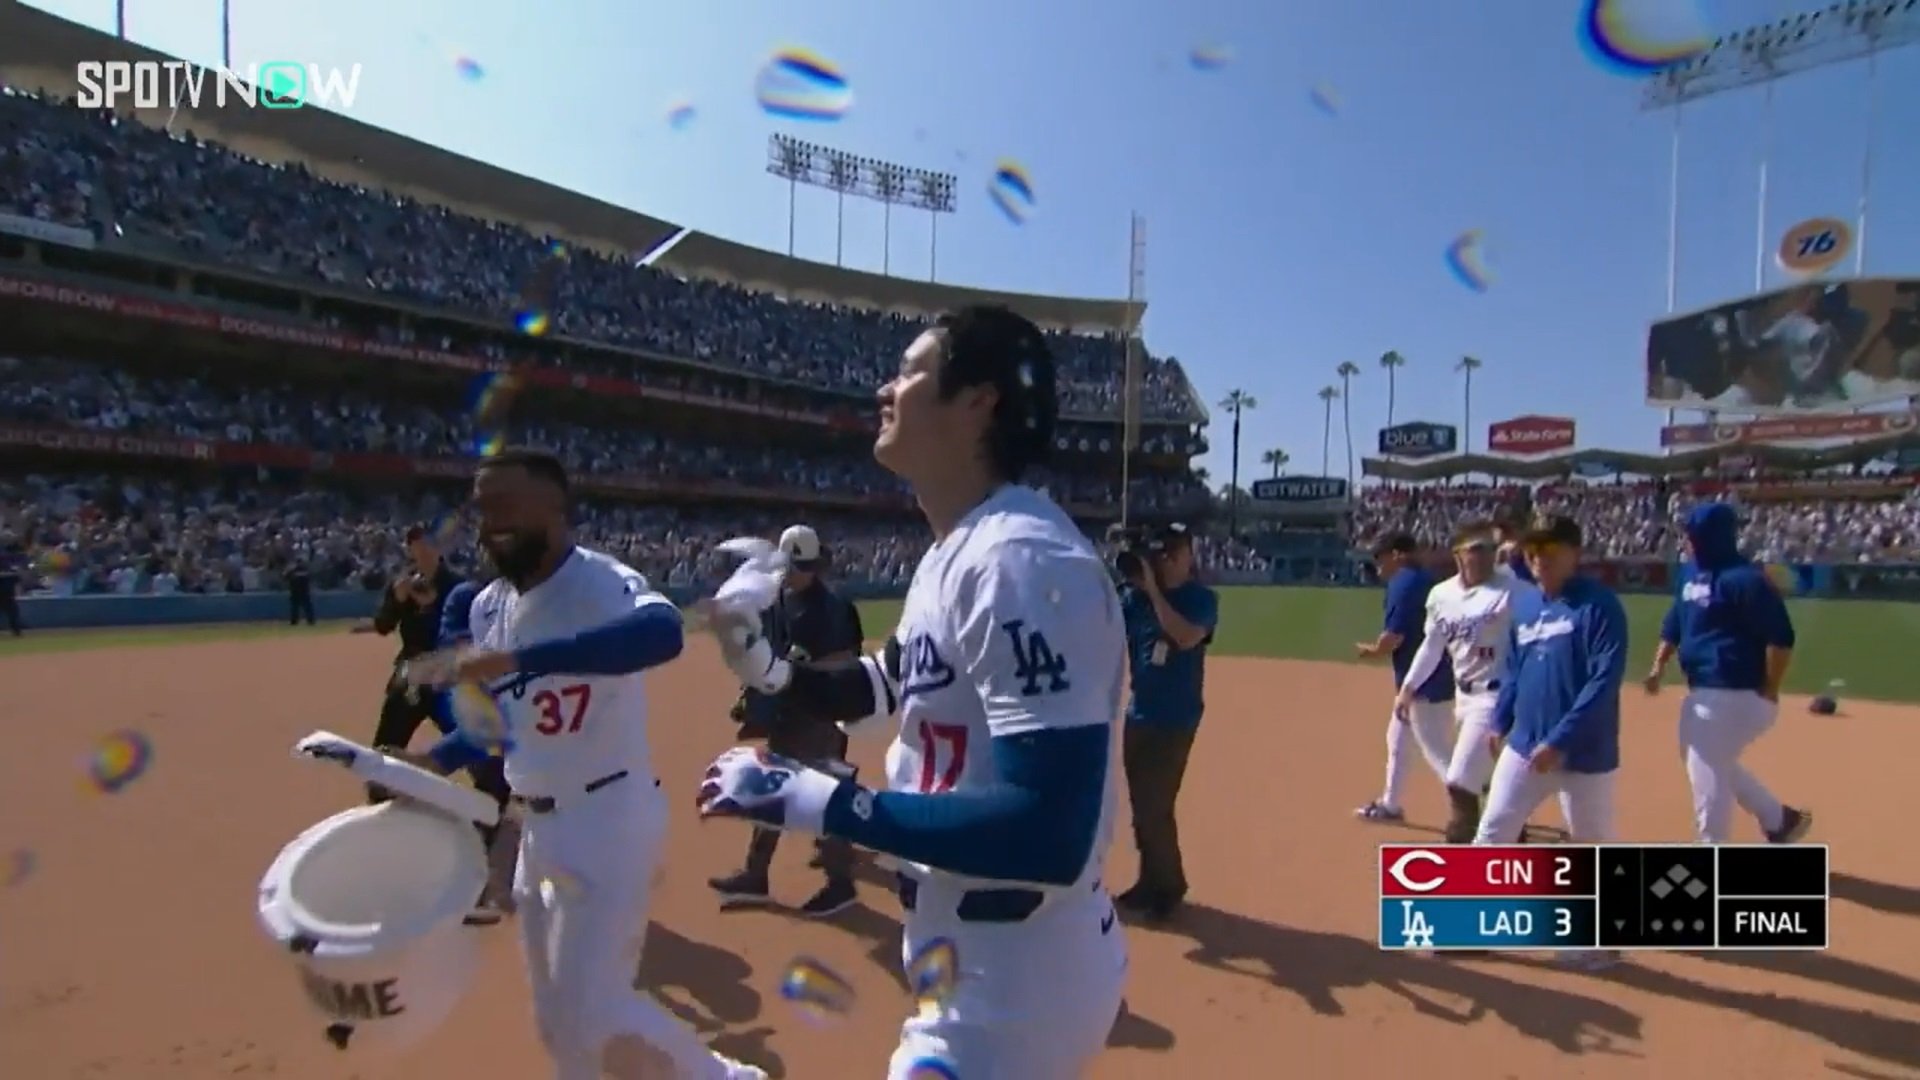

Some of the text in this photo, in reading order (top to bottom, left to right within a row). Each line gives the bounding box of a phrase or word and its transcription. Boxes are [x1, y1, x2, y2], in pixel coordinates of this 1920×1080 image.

[1796, 230, 1836, 257] 76
[1385, 429, 1429, 446] blue
[1001, 619, 1070, 696] LA
[531, 684, 592, 735] 37
[919, 719, 968, 794] 17
